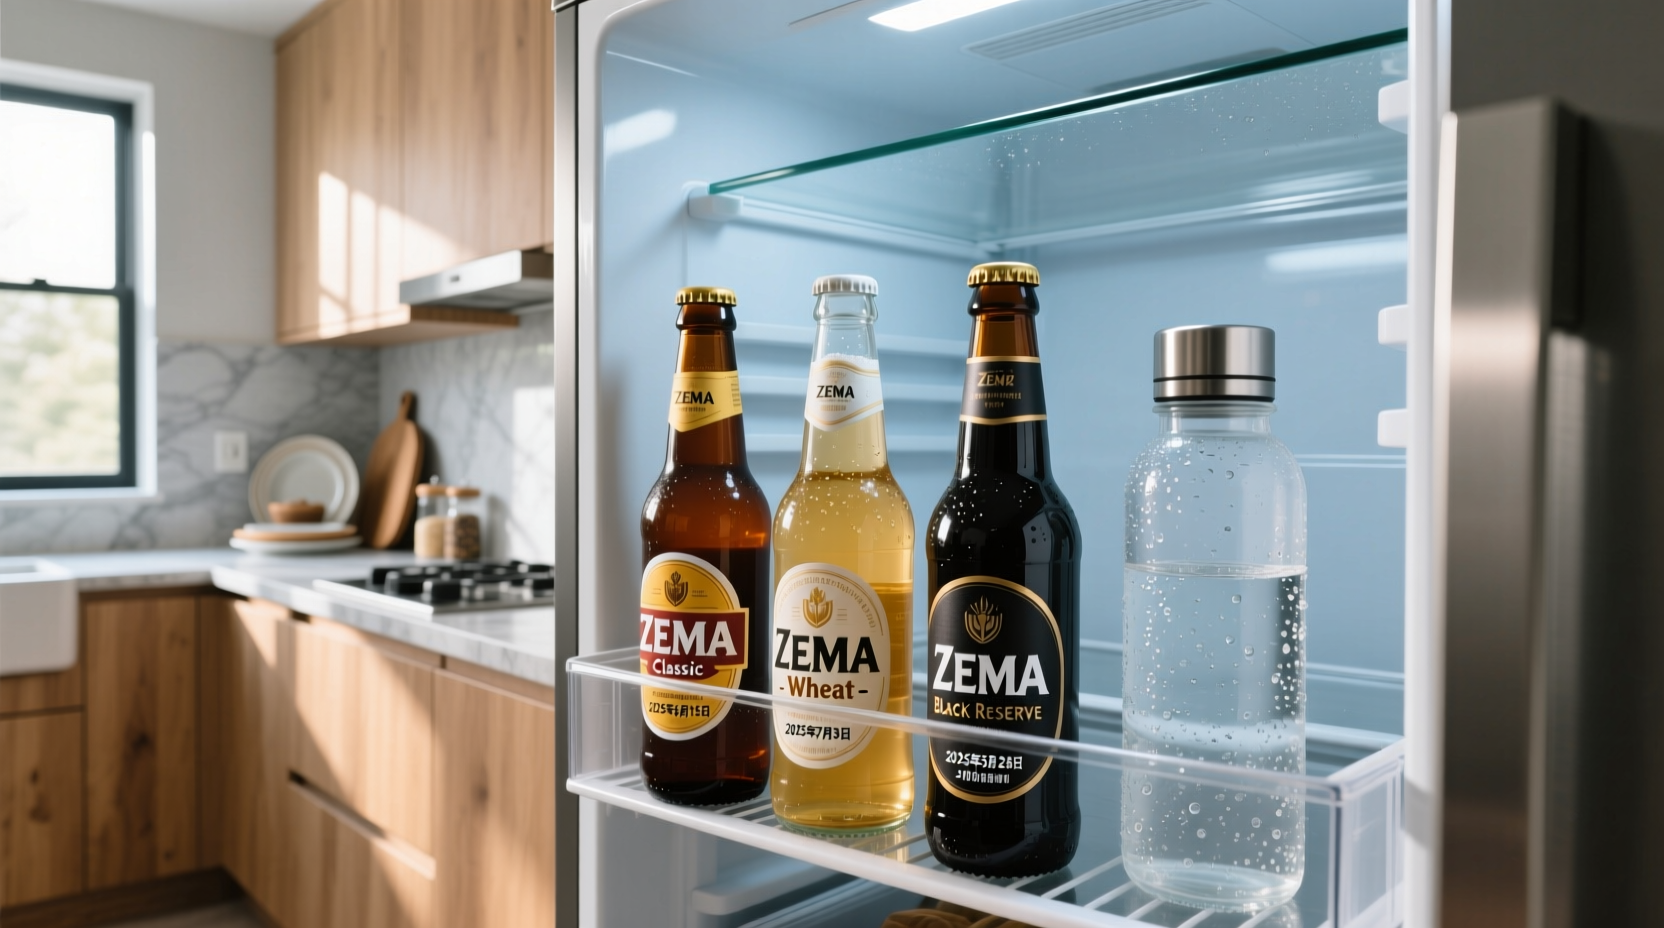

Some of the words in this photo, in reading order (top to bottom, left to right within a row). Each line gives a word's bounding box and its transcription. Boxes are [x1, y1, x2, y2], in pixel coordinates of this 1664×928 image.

[674, 391, 714, 404] ZEMA
[816, 385, 855, 398] ZEMA
[640, 613, 737, 656] ZEMA
[775, 627, 880, 673] ZEMA
[652, 658, 704, 676] Classic
[933, 644, 1050, 696] ZEMA
[976, 702, 1042, 721] RESERVE
[785, 723, 851, 740] 2025年7月3日
